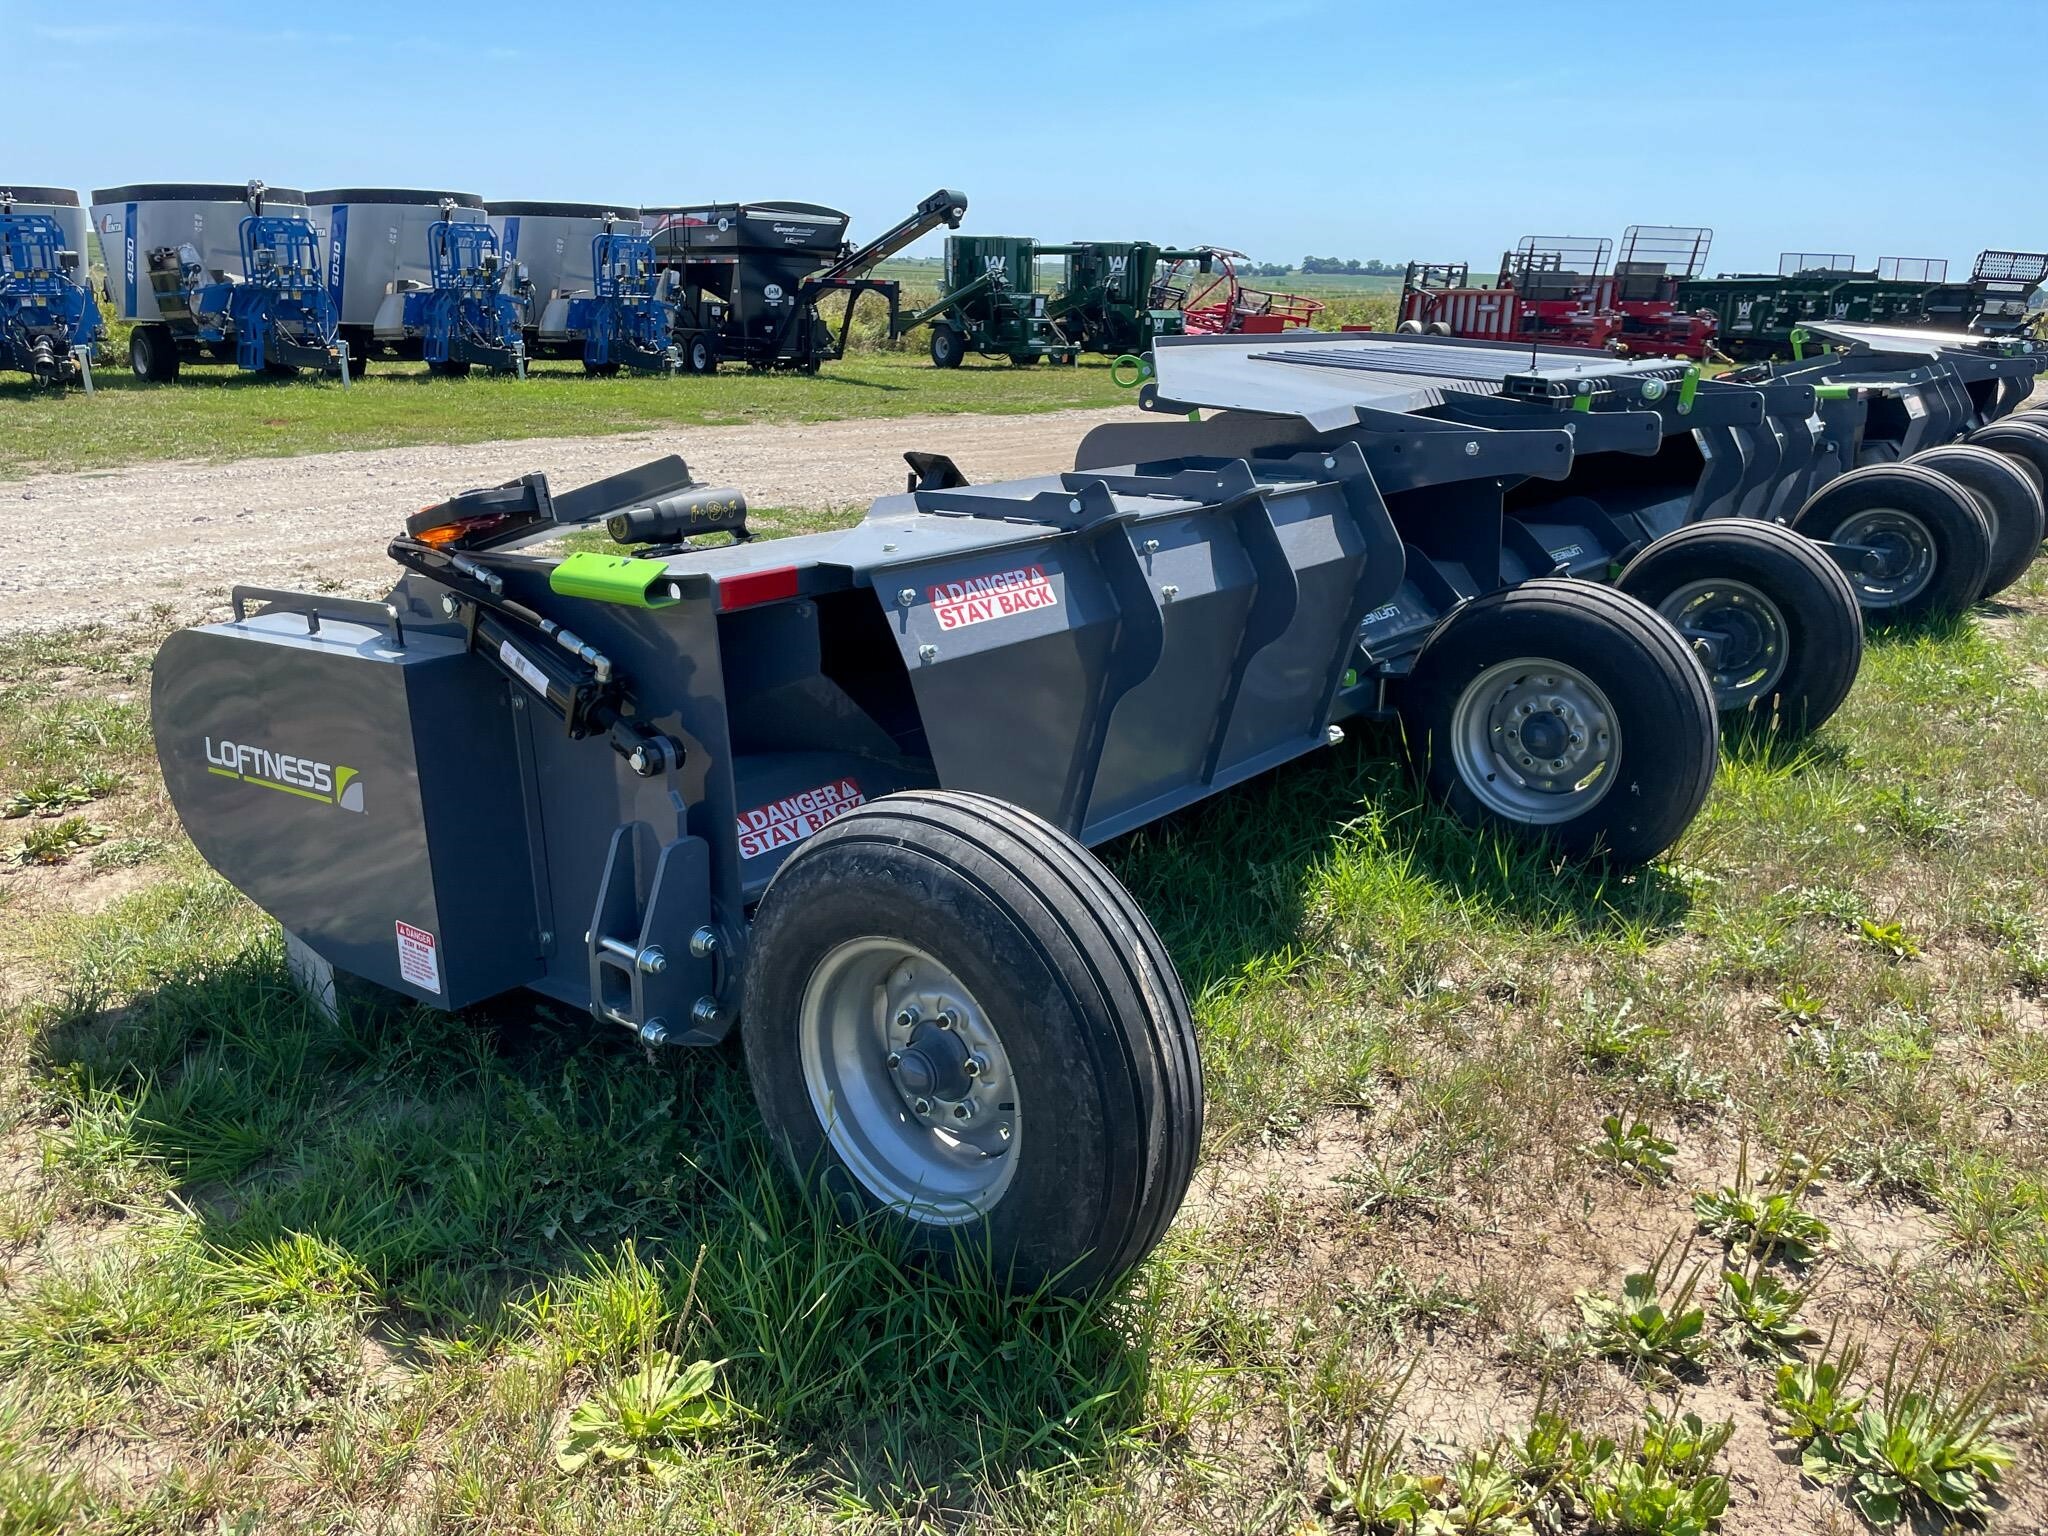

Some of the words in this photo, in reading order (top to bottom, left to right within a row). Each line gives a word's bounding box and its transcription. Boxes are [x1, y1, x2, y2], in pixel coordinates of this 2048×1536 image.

[127, 237, 135, 284] 4830
[331, 241, 341, 287] 5030
[939, 598, 995, 628] STAY
[999, 586, 1053, 615] BACK
[946, 570, 1031, 604] DANGER
[205, 736, 332, 792] LOFTNESS
[747, 785, 842, 830] DANGER
[740, 820, 801, 856] STAY
[405, 927, 432, 946] DANGER
